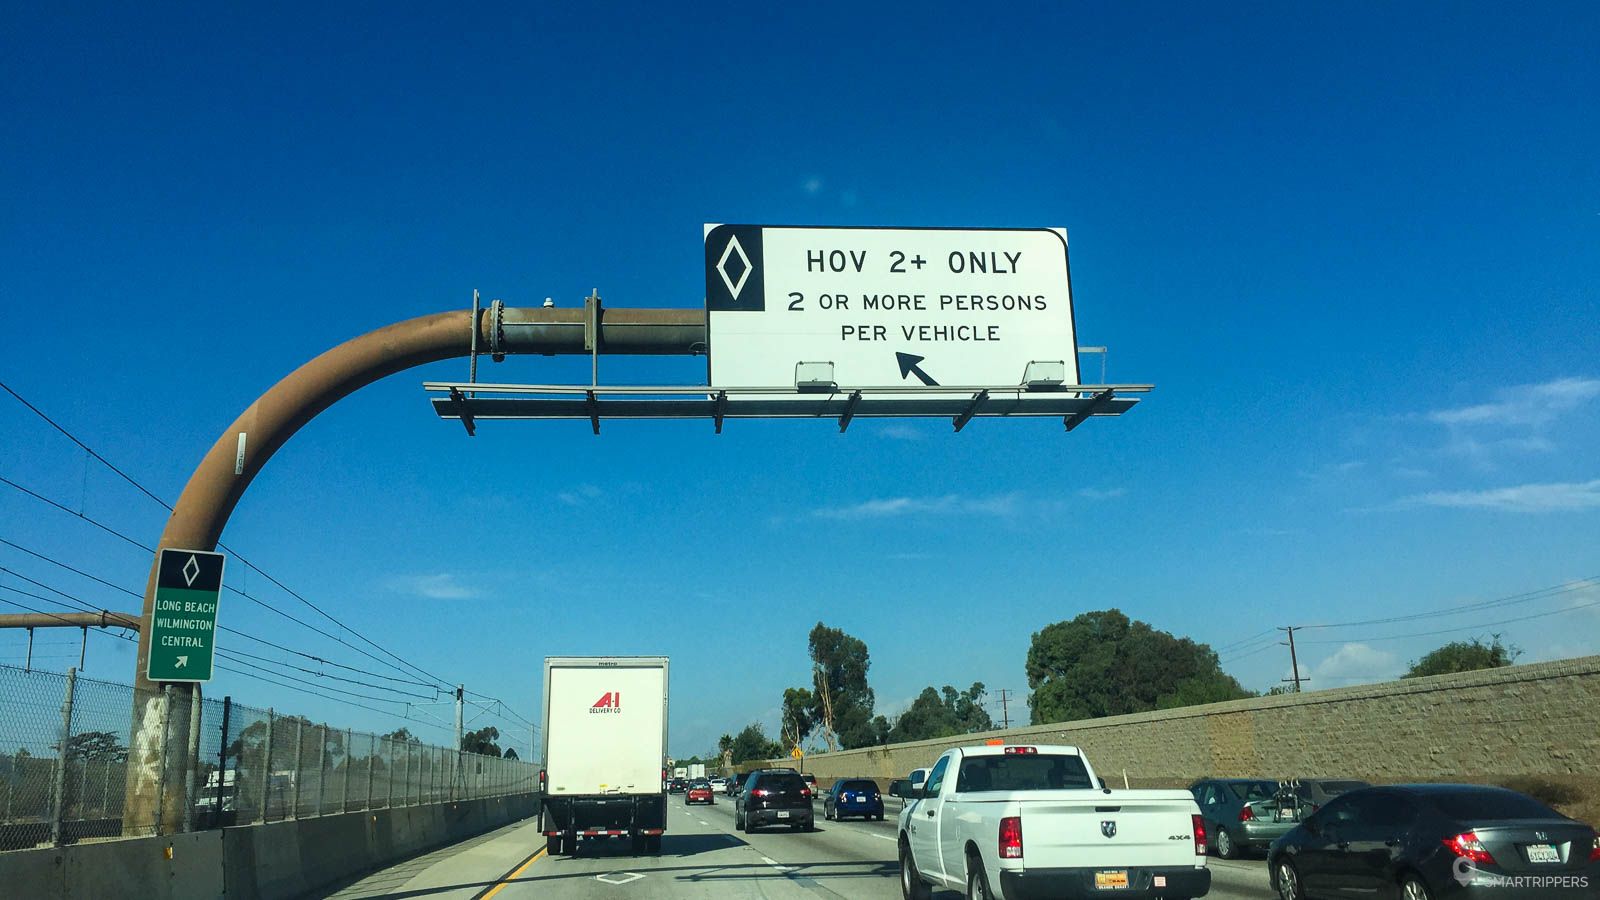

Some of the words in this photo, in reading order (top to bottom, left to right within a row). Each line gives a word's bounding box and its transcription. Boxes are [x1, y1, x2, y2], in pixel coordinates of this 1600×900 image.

[807, 250, 867, 273] HOV
[889, 250, 927, 273] 2+
[949, 251, 1022, 274] ONLY
[787, 292, 805, 311] 2
[819, 294, 849, 310] OR
[863, 294, 926, 311] MORE
[940, 294, 1047, 311] PERSONS
[841, 325, 887, 341] PER
[901, 325, 1001, 341] VEHICLE
[157, 600, 182, 612] LONG
[184, 602, 215, 613] BEACH
[156, 618, 213, 630] WILMINGTON
[161, 635, 204, 648] CENTRAL
